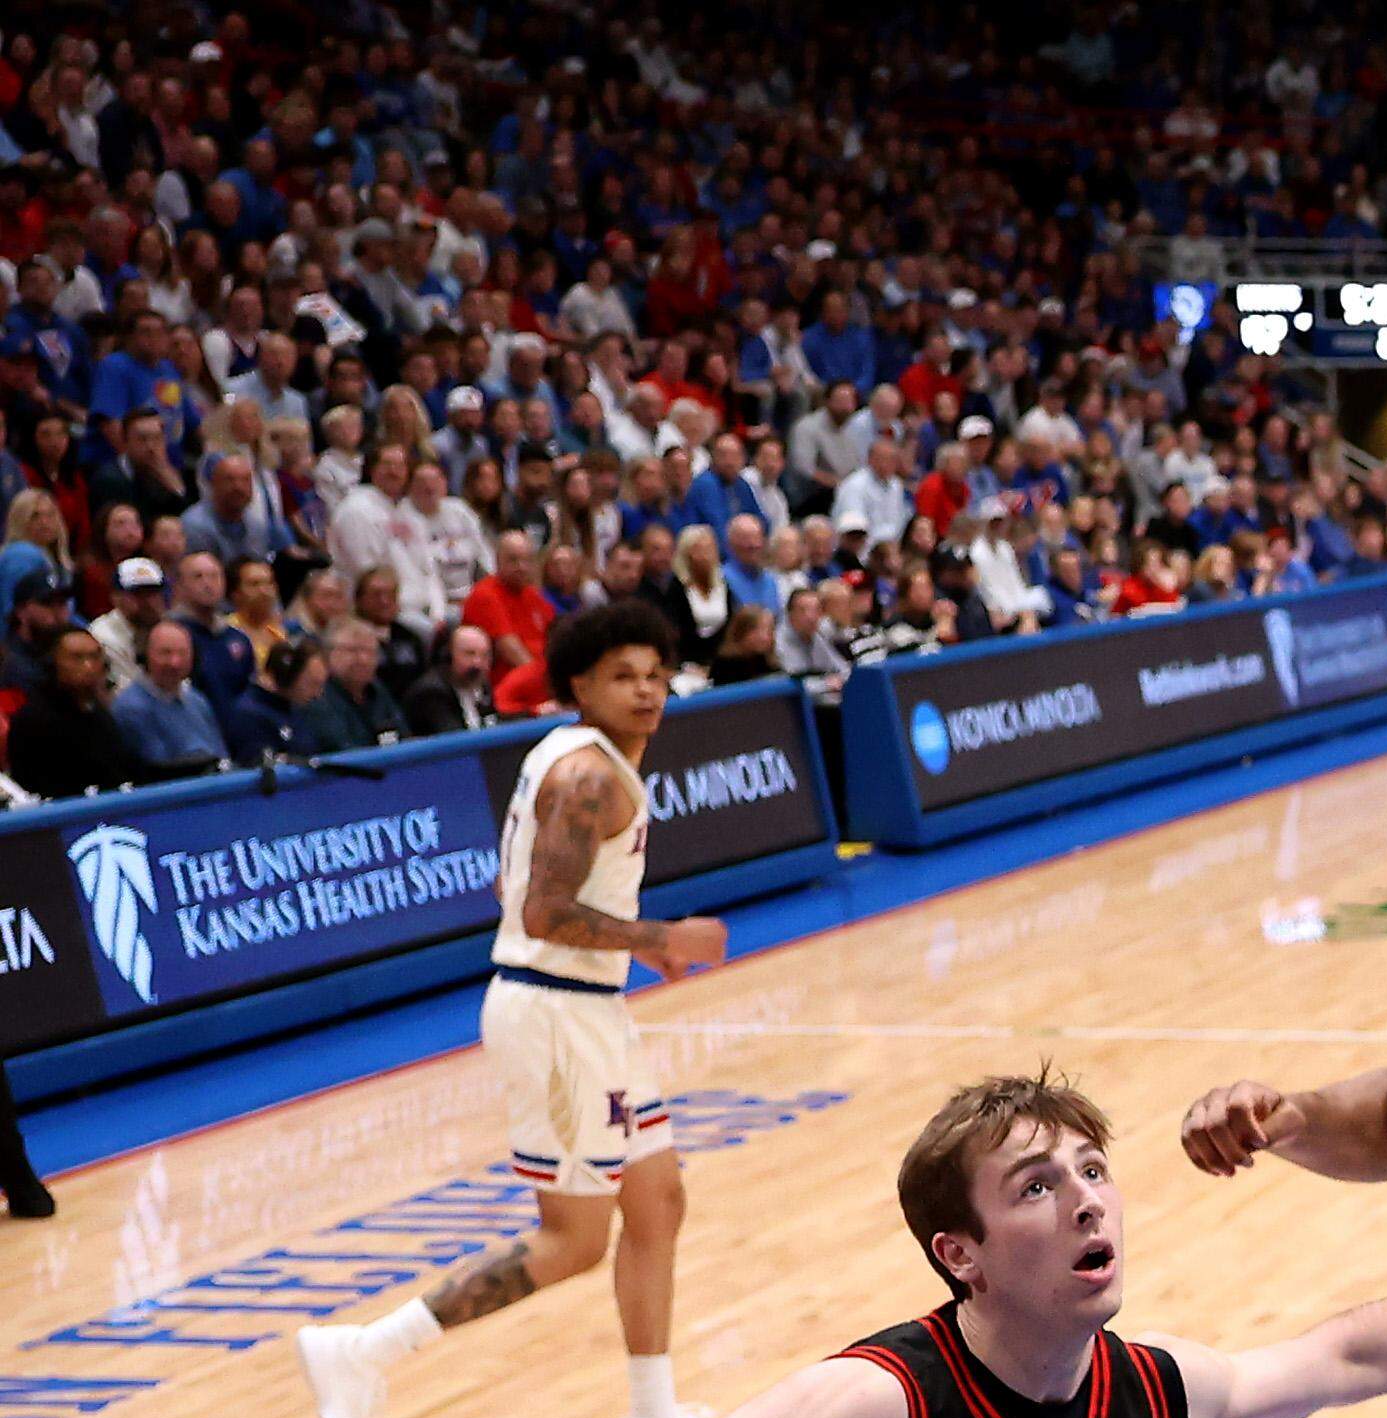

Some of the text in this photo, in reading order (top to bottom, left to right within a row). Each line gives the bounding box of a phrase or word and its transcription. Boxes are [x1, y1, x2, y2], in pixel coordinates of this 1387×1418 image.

[644, 747, 798, 824] CA MINOLTA
[159, 806, 441, 906] THE UNIVERSITY OF
[0, 907, 56, 974] TA
[175, 848, 500, 960] KANSAS HEALTH SYSTEM
